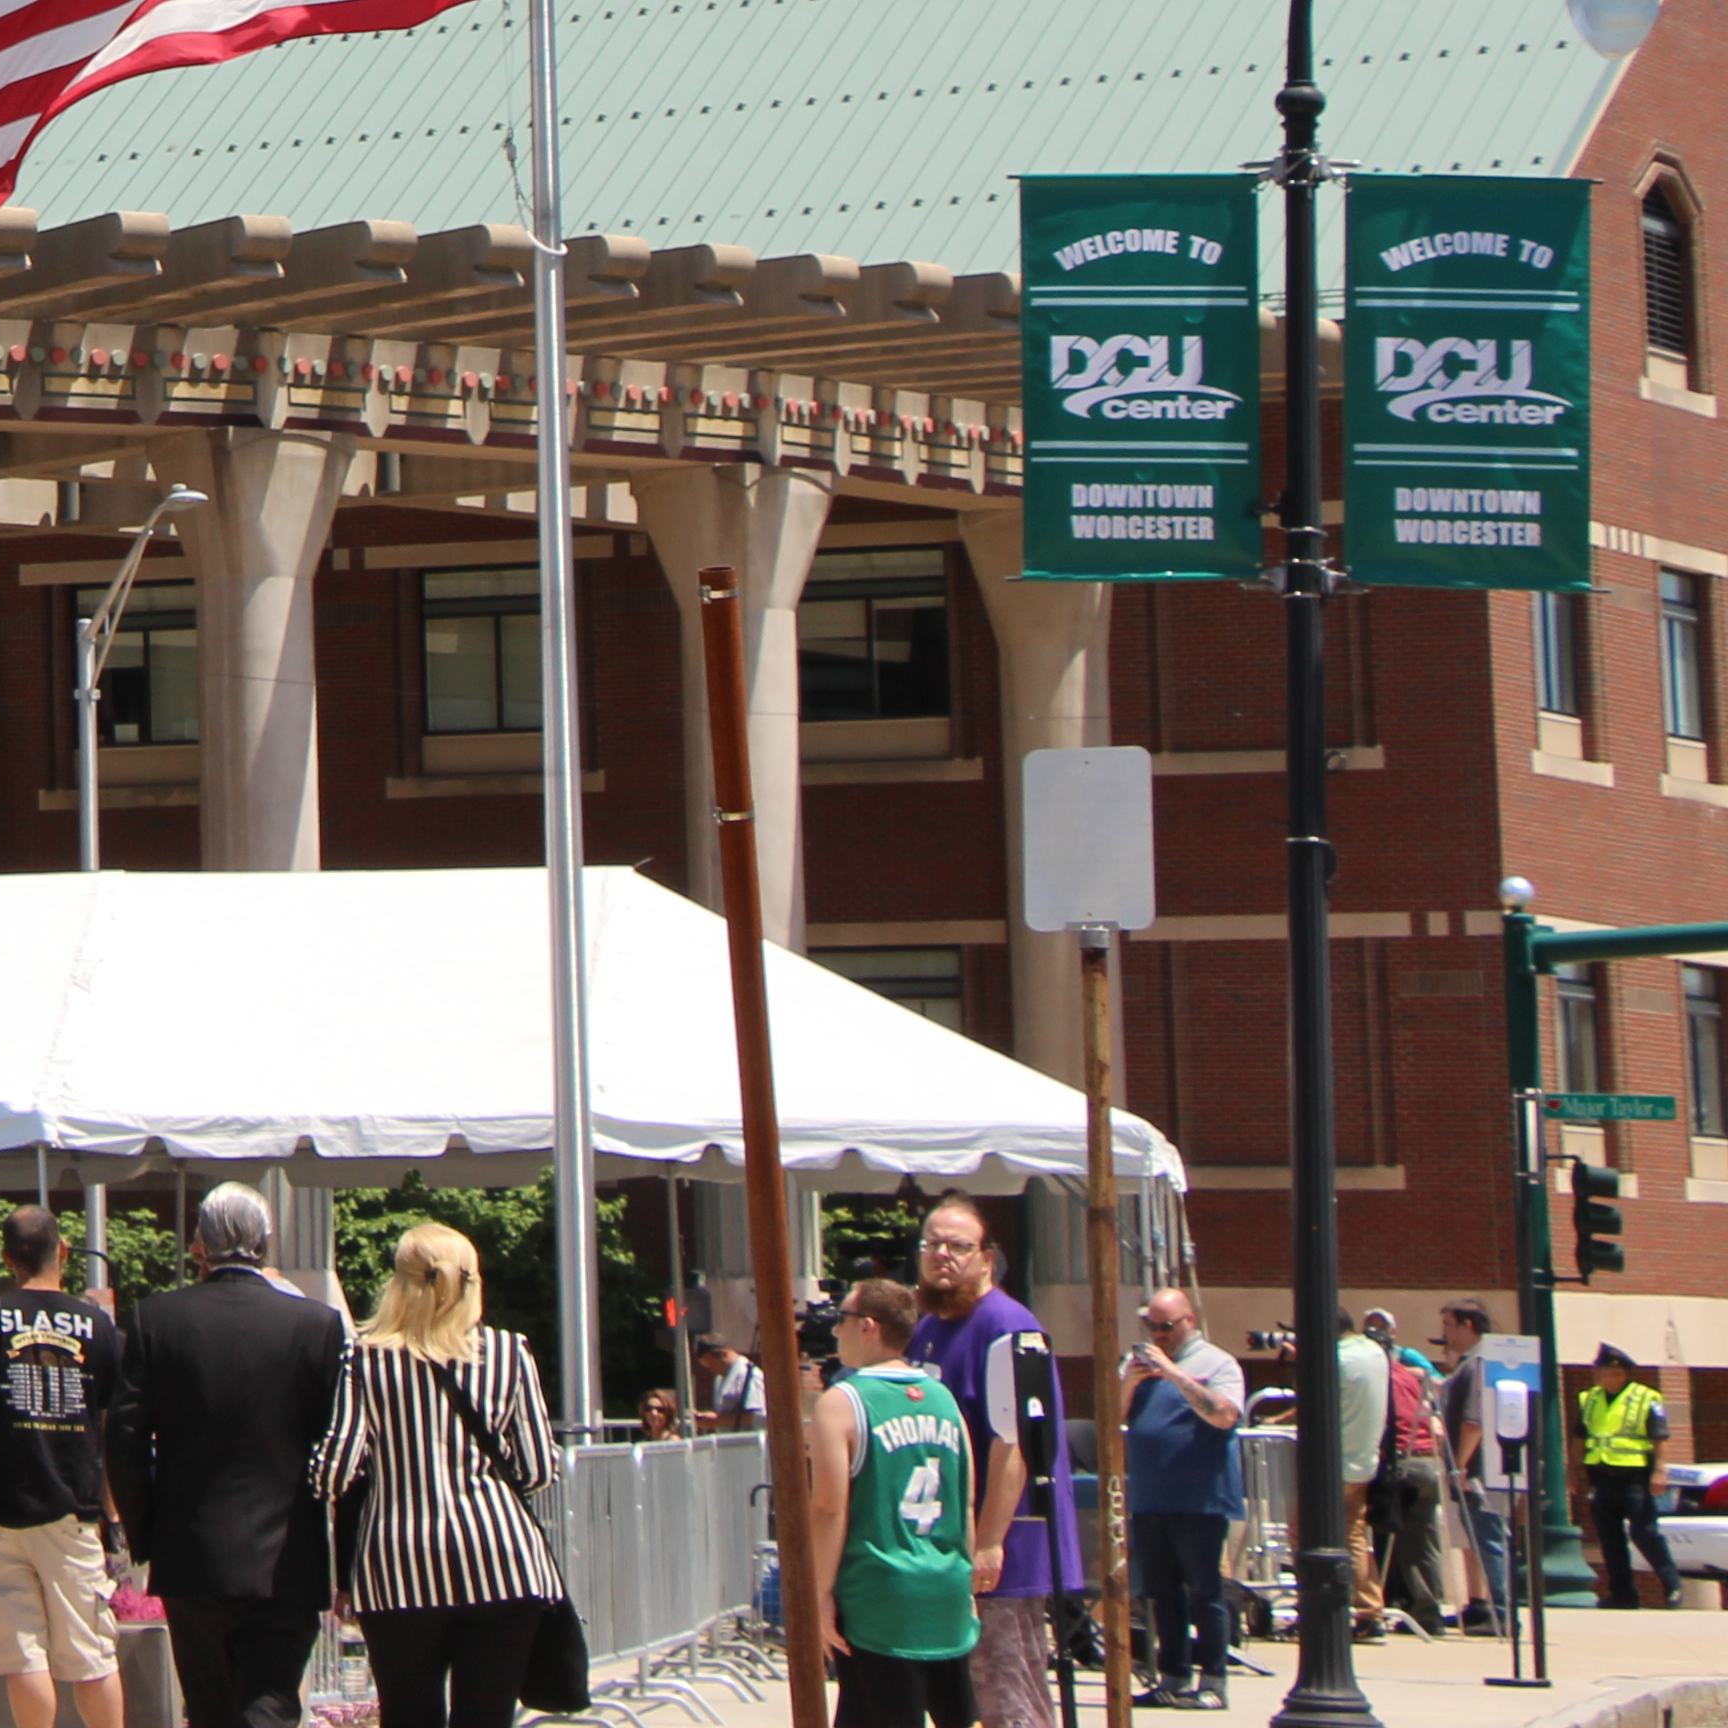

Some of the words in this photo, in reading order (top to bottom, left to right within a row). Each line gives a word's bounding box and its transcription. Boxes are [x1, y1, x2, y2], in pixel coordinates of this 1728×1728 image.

[1052, 228, 1181, 272] WELCOME
[1188, 234, 1224, 266] TO
[1378, 230, 1511, 273] WELCOME
[1518, 238, 1555, 270] TO
[1049, 333, 1204, 390] DCU
[1374, 336, 1533, 392] DCU
[1100, 393, 1236, 420] center
[1425, 398, 1565, 425] center
[1070, 483, 1215, 509] DOWNTOWN
[1394, 486, 1542, 515] DOWNTOWN
[1069, 514, 1215, 540] WORCESTER
[1394, 517, 1543, 547] WORCESTER
[0, 1308, 94, 1340] SLASH
[898, 1456, 943, 1536] 4
